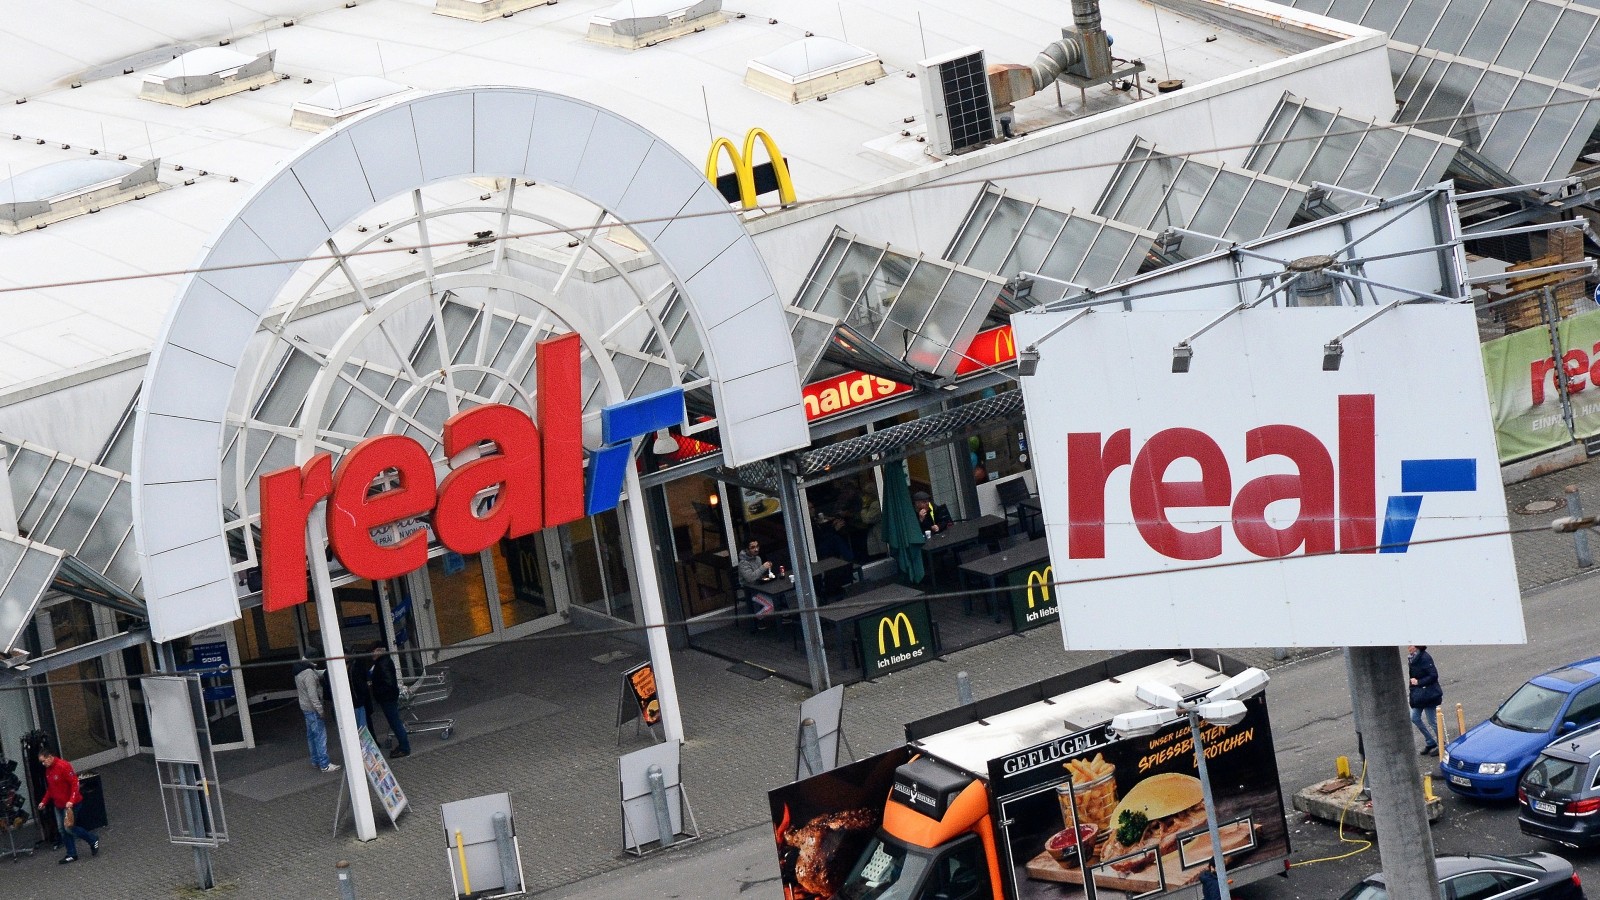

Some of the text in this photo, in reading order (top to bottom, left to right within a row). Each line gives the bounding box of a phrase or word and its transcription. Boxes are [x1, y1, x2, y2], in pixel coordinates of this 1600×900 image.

[1531, 342, 1600, 405] re
[1532, 407, 1578, 431] EINML
[1026, 611, 1039, 622] ich
[877, 658, 890, 669] ich
[891, 653, 911, 664] liebe
[1149, 732, 1174, 749] UNSER
[1004, 735, 1098, 776] GEFLÜGEL
